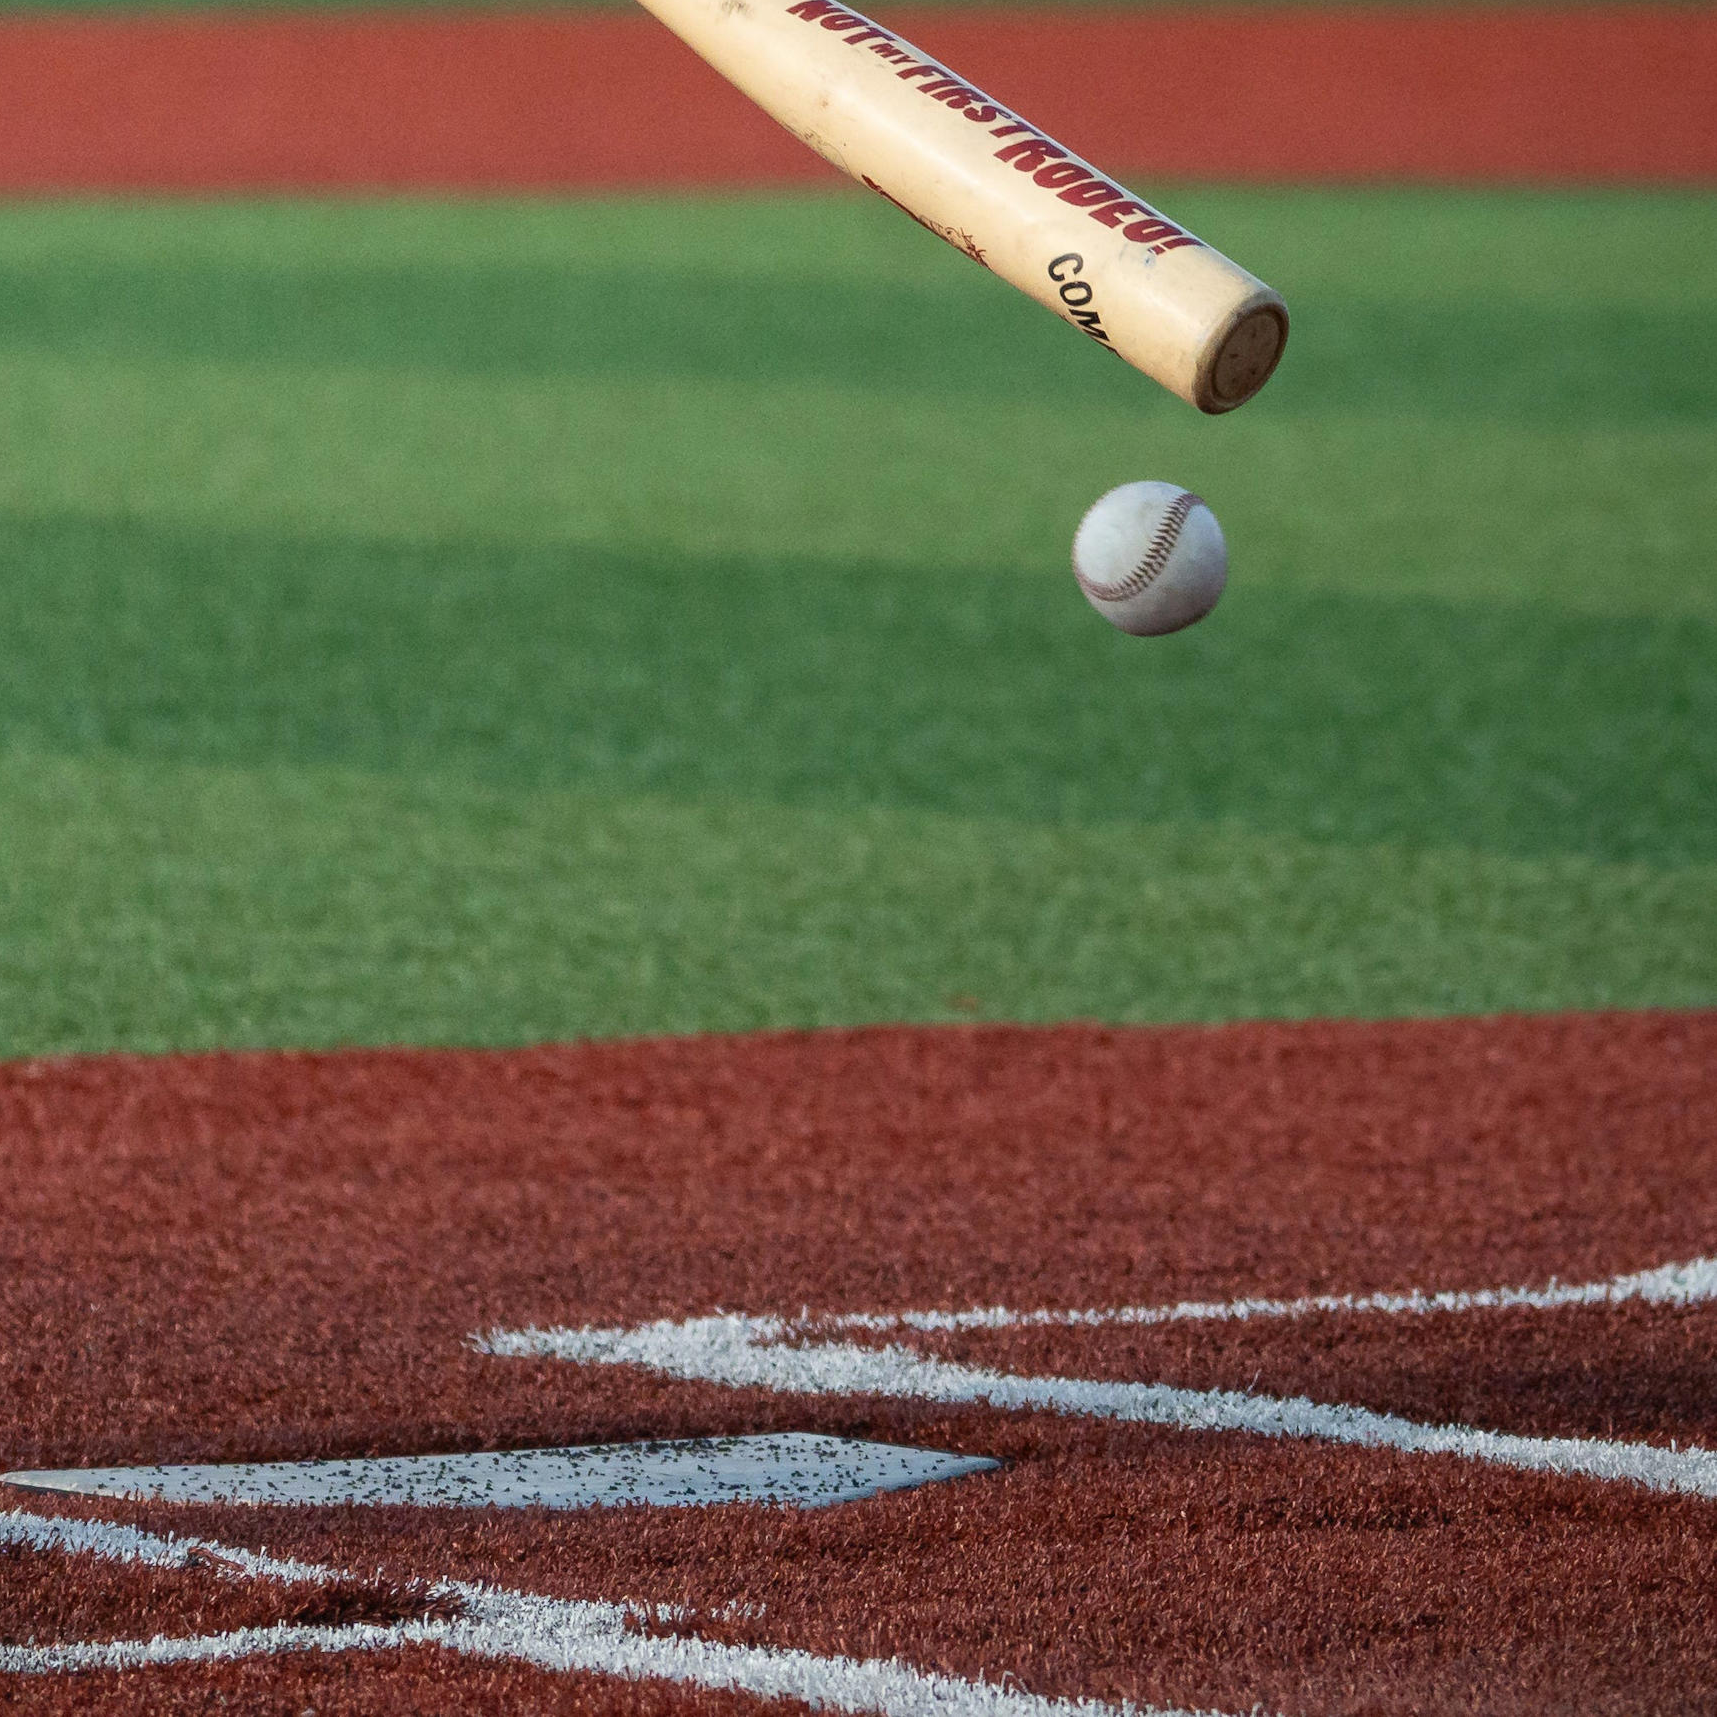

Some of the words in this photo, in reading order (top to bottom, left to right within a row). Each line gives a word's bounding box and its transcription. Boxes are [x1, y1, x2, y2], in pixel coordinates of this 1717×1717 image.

[867, 42, 920, 66] MY
[895, 64, 1045, 139] FIRST
[992, 138, 1211, 256] RODEO!
